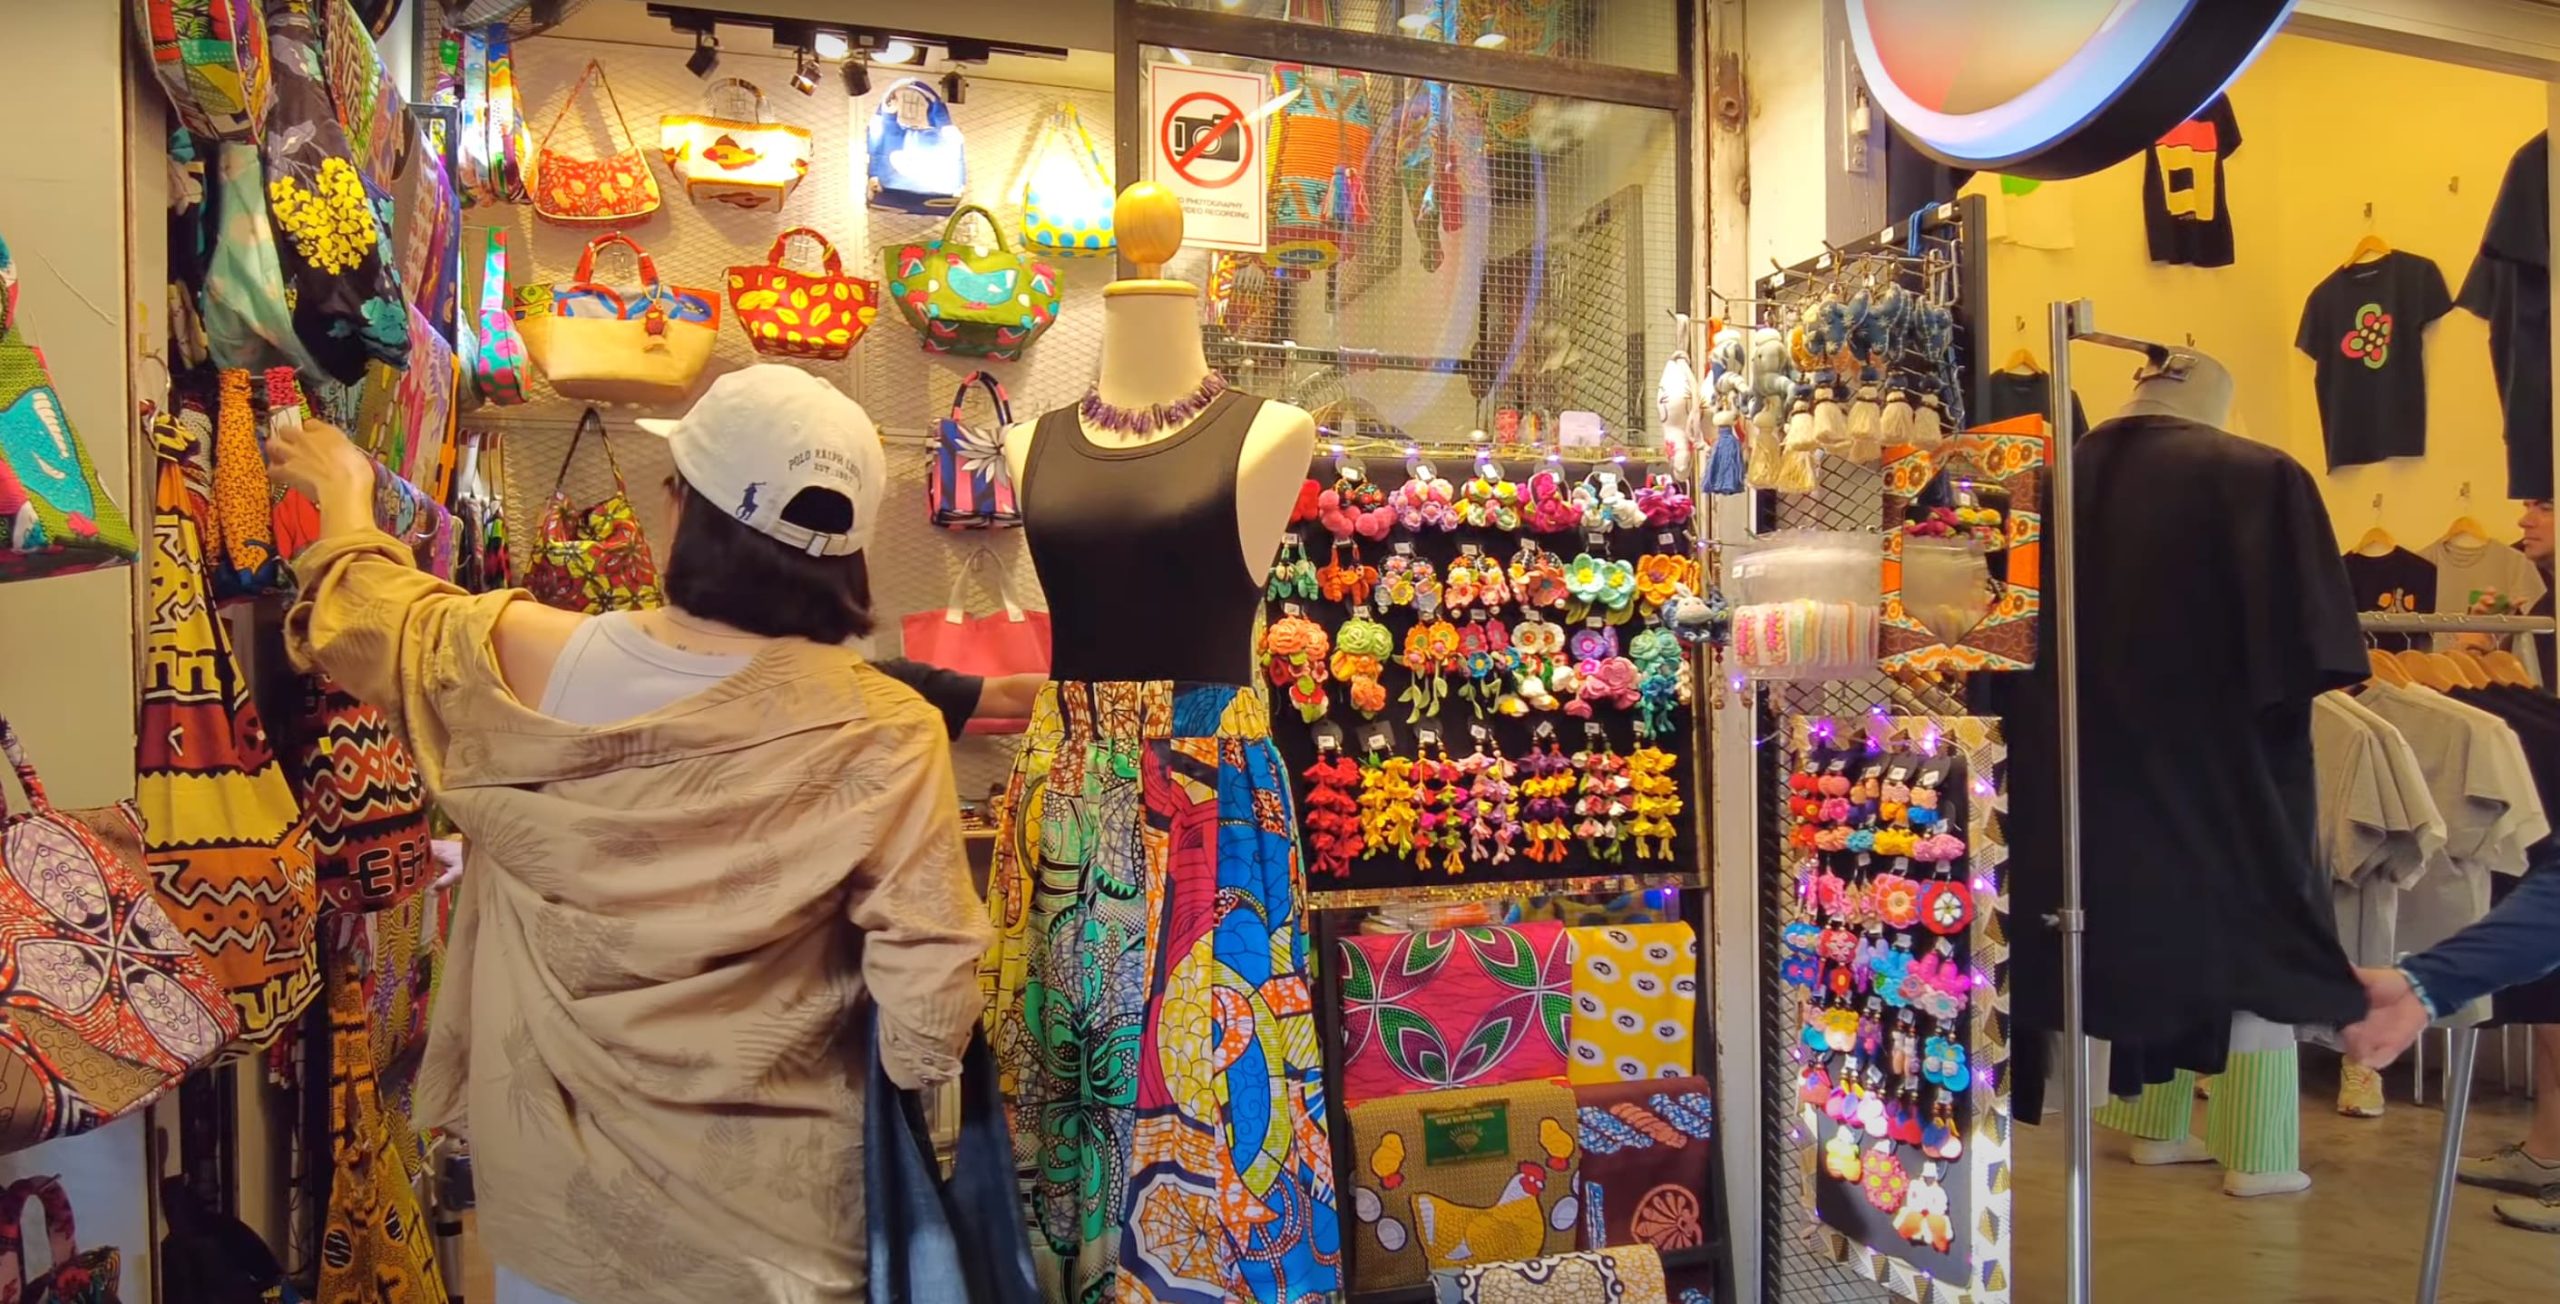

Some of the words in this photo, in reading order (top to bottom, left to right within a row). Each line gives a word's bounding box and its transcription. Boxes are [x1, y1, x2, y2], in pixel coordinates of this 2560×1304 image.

[1186, 198, 1243, 208] PHOTOGRAPHY
[1183, 206, 1203, 214] IDEO
[1205, 208, 1249, 219] RECORDING
[788, 450, 811, 470] POLO
[815, 449, 843, 466] RALPH
